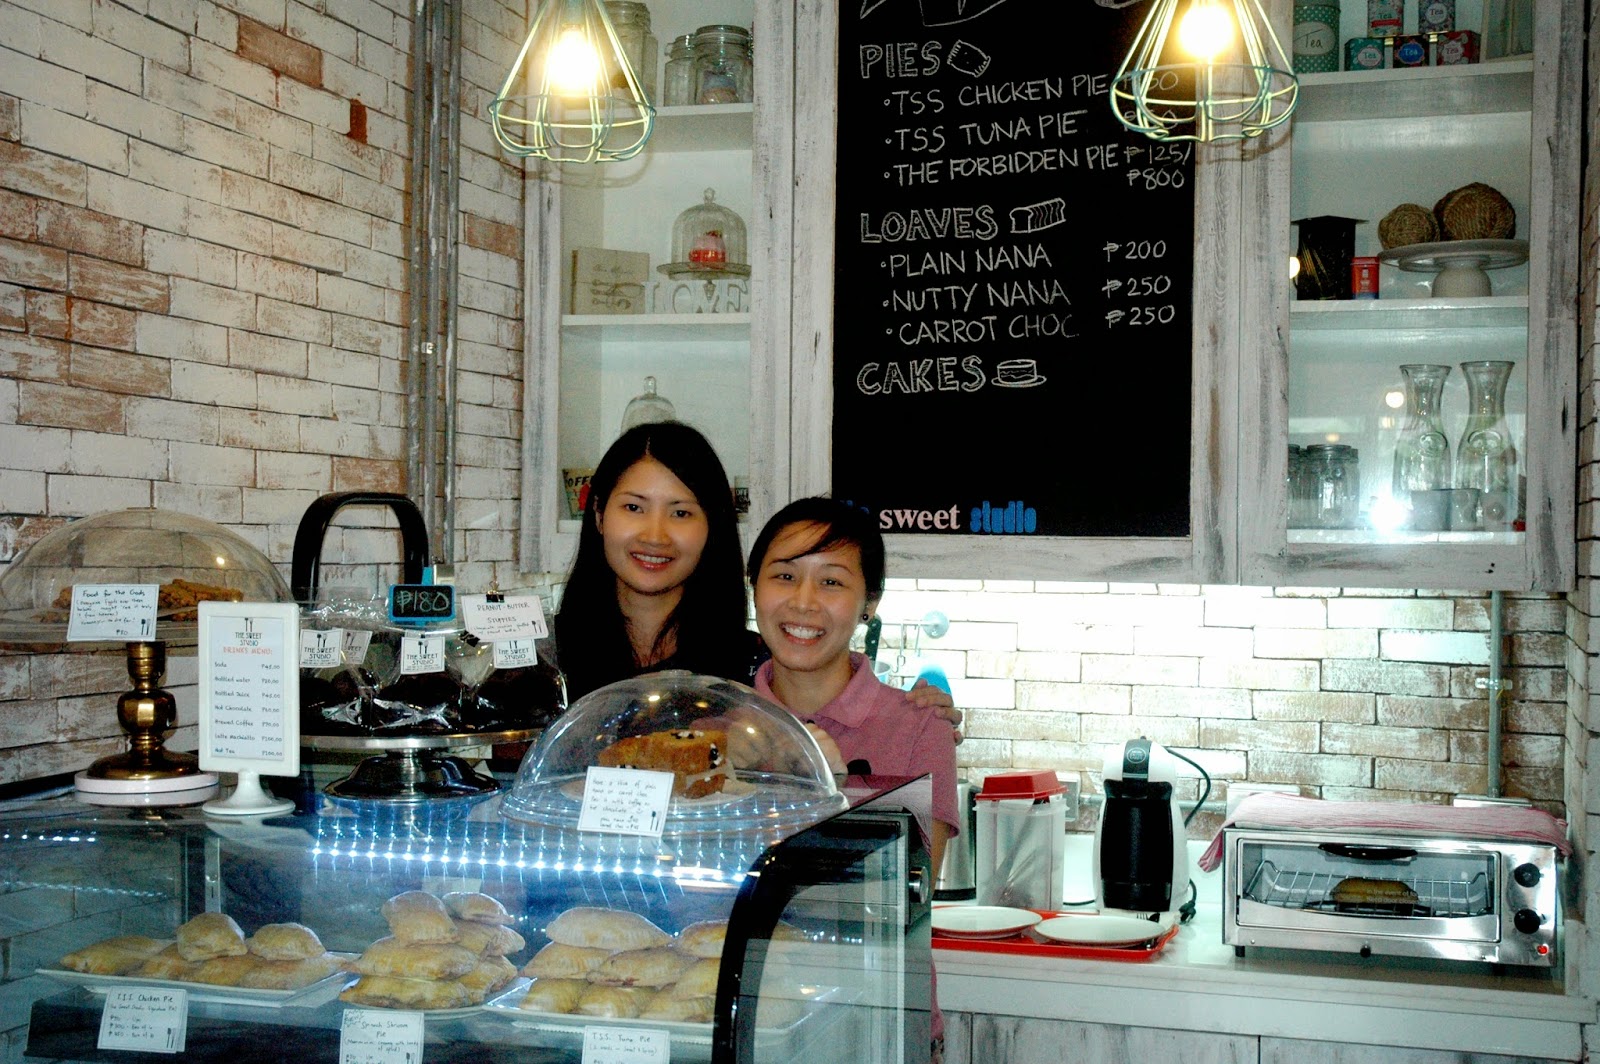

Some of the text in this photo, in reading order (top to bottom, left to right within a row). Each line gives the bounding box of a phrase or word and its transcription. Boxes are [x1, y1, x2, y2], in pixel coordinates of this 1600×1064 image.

[1430, 8, 1444, 16] Tea
[1295, 28, 1324, 49] Tea
[1362, 51, 1377, 60] Tea
[859, 40, 943, 79] PIES
[892, 88, 945, 116] TSS
[959, 77, 1063, 108] CHICKEN
[1072, 74, 1110, 97] PIE
[895, 125, 946, 153] TSS
[959, 117, 1033, 146] TUNA
[1039, 109, 1088, 138] PIE
[893, 160, 944, 186] THE
[949, 148, 1079, 180] FORBIDDEN
[1086, 143, 1119, 170] PIE
[860, 204, 999, 244] LOAVES
[889, 249, 966, 278] PLAIN
[975, 243, 1053, 273] NANA
[892, 282, 979, 313] NUTTY
[987, 279, 1072, 308] NANA
[899, 315, 998, 345] CARROT
[1008, 313, 1078, 340] CHOC
[856, 355, 987, 396] CAKES
[879, 504, 961, 531] sweet
[970, 500, 1038, 534] studio
[82, 590, 99, 598] Food
[104, 589, 112, 598] for
[138, 994, 160, 1002] Chicken
[163, 995, 174, 1003] Pie
[618, 1034, 633, 1043] Tuna
[640, 1035, 651, 1043] Pie
